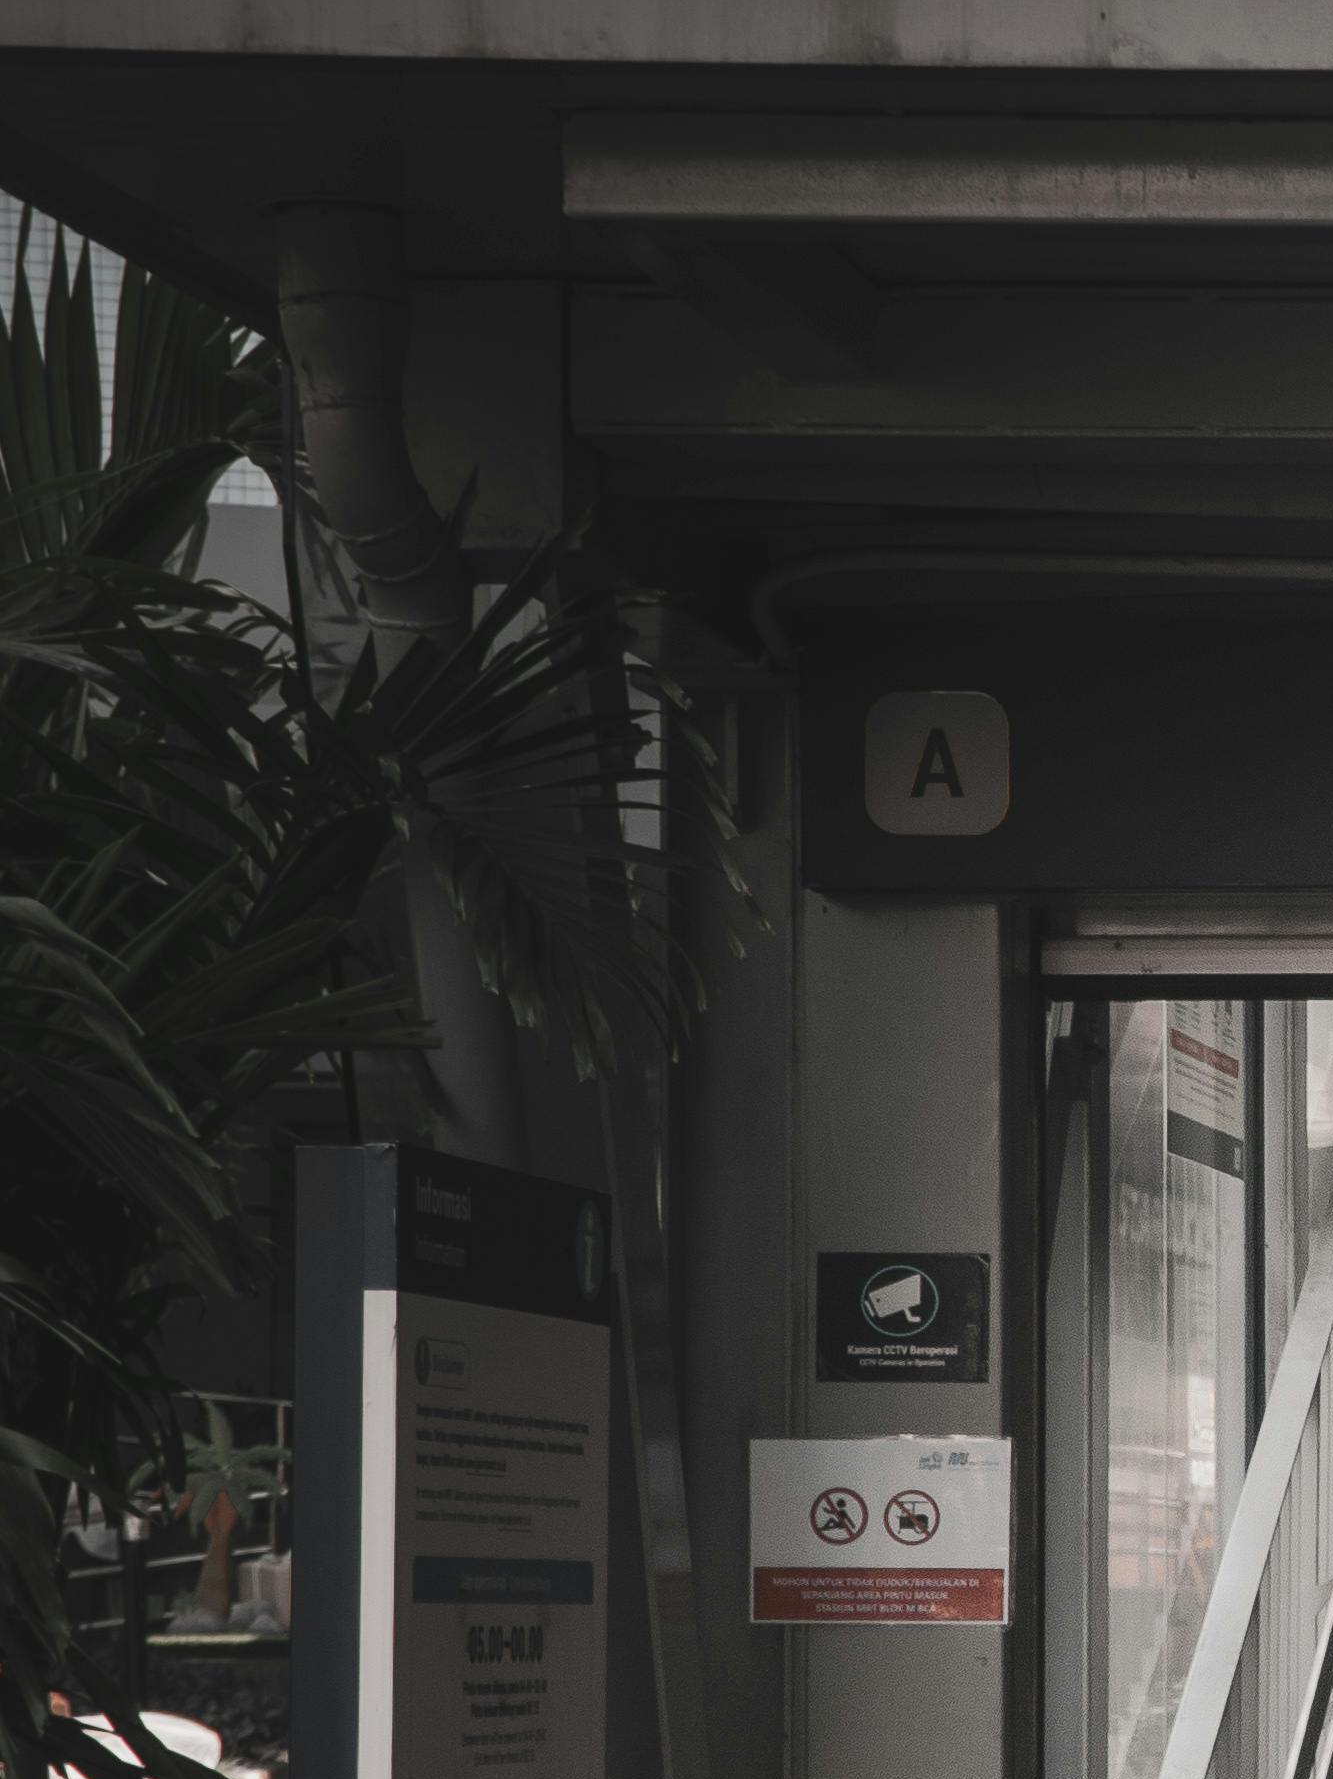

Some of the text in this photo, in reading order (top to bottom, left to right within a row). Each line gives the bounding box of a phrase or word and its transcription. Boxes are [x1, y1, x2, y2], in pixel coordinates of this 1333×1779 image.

[908, 727, 966, 800] A
[414, 1174, 473, 1223] Informasi
[883, 1344, 908, 1355] CCTV
[771, 1577, 809, 1588] MOHON
[811, 1577, 843, 1588] UNTUK
[846, 1578, 874, 1588] TIDAK
[856, 1590, 881, 1601] AREA
[883, 1590, 911, 1601] PINTU
[913, 1590, 948, 1601] MASUK
[856, 1603, 877, 1614] MRT
[879, 1603, 903, 1614] BLOK
